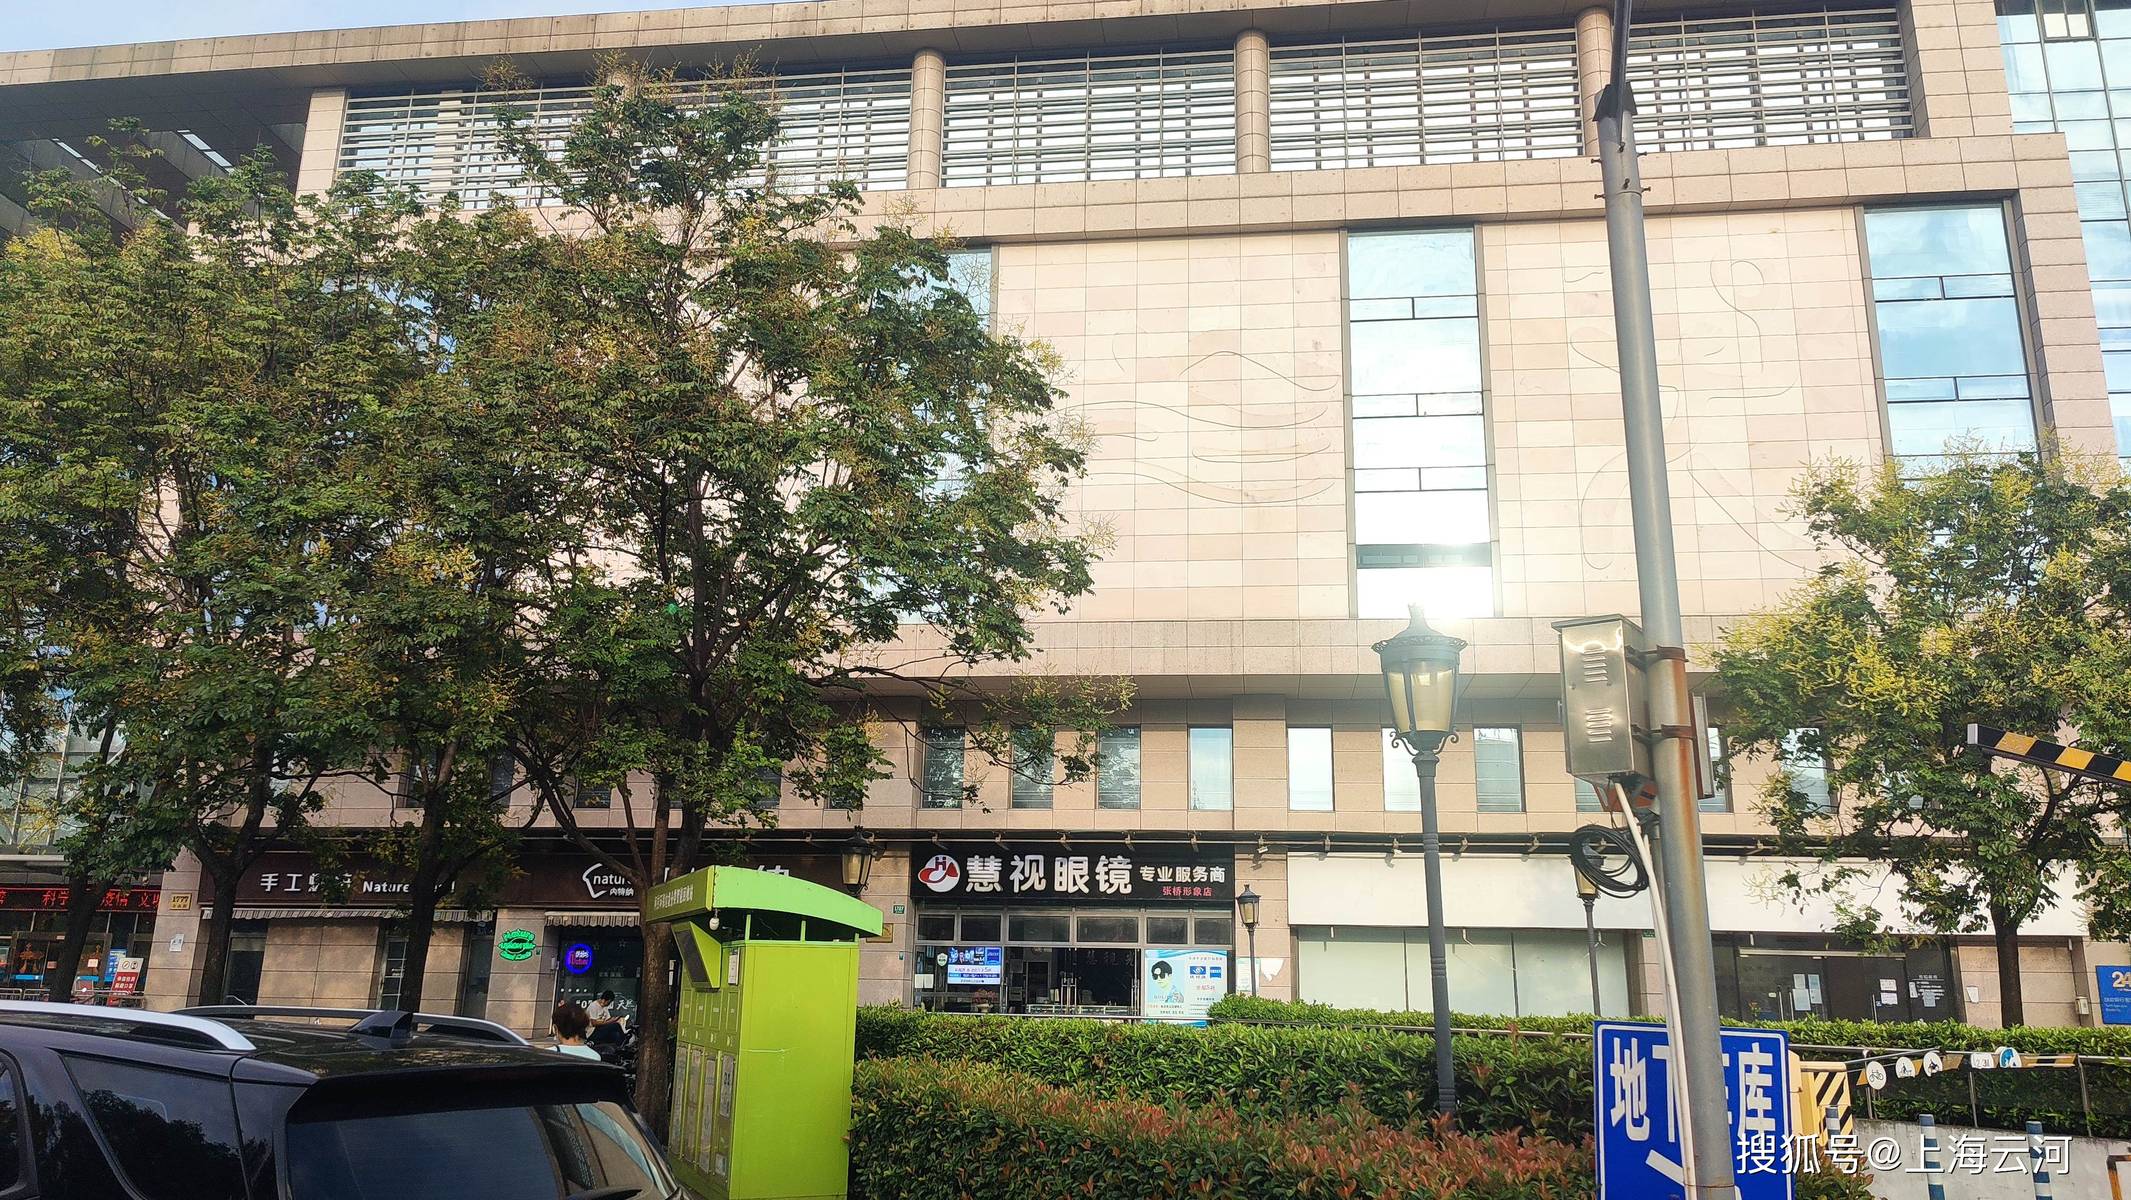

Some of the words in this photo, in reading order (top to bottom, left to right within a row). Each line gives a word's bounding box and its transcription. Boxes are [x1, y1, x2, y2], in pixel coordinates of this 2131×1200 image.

[261, 873, 352, 892] 手工
[965, 855, 1133, 895] 慧视眼镜
[1139, 865, 1226, 884] 专业服务商
[363, 881, 409, 893] Nature
[609, 887, 634, 897] 内特纳
[1162, 885, 1213, 897] 张桥形象店
[1610, 1037, 1776, 1143] 地下库
